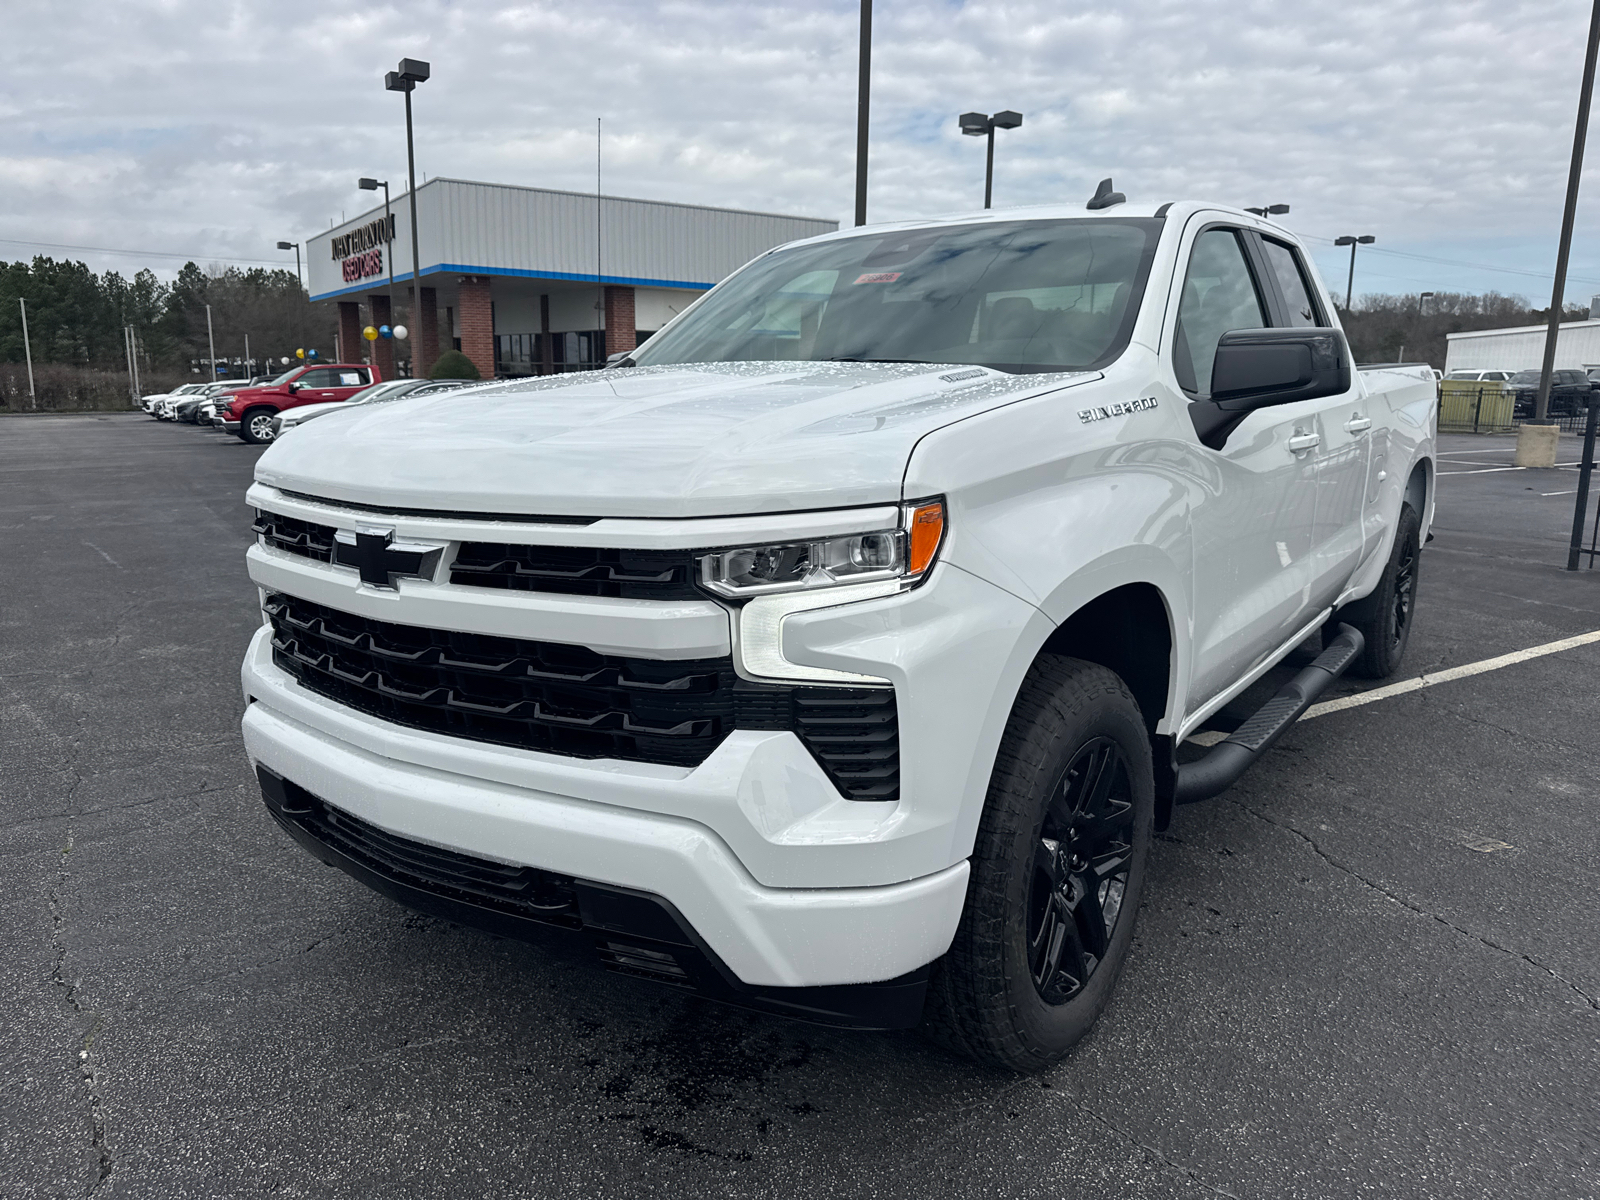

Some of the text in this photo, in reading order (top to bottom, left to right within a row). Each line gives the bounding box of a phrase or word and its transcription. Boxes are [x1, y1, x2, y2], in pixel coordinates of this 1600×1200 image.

[342, 249, 382, 282] USED CARS
[1077, 397, 1158, 424] SILVERADO
